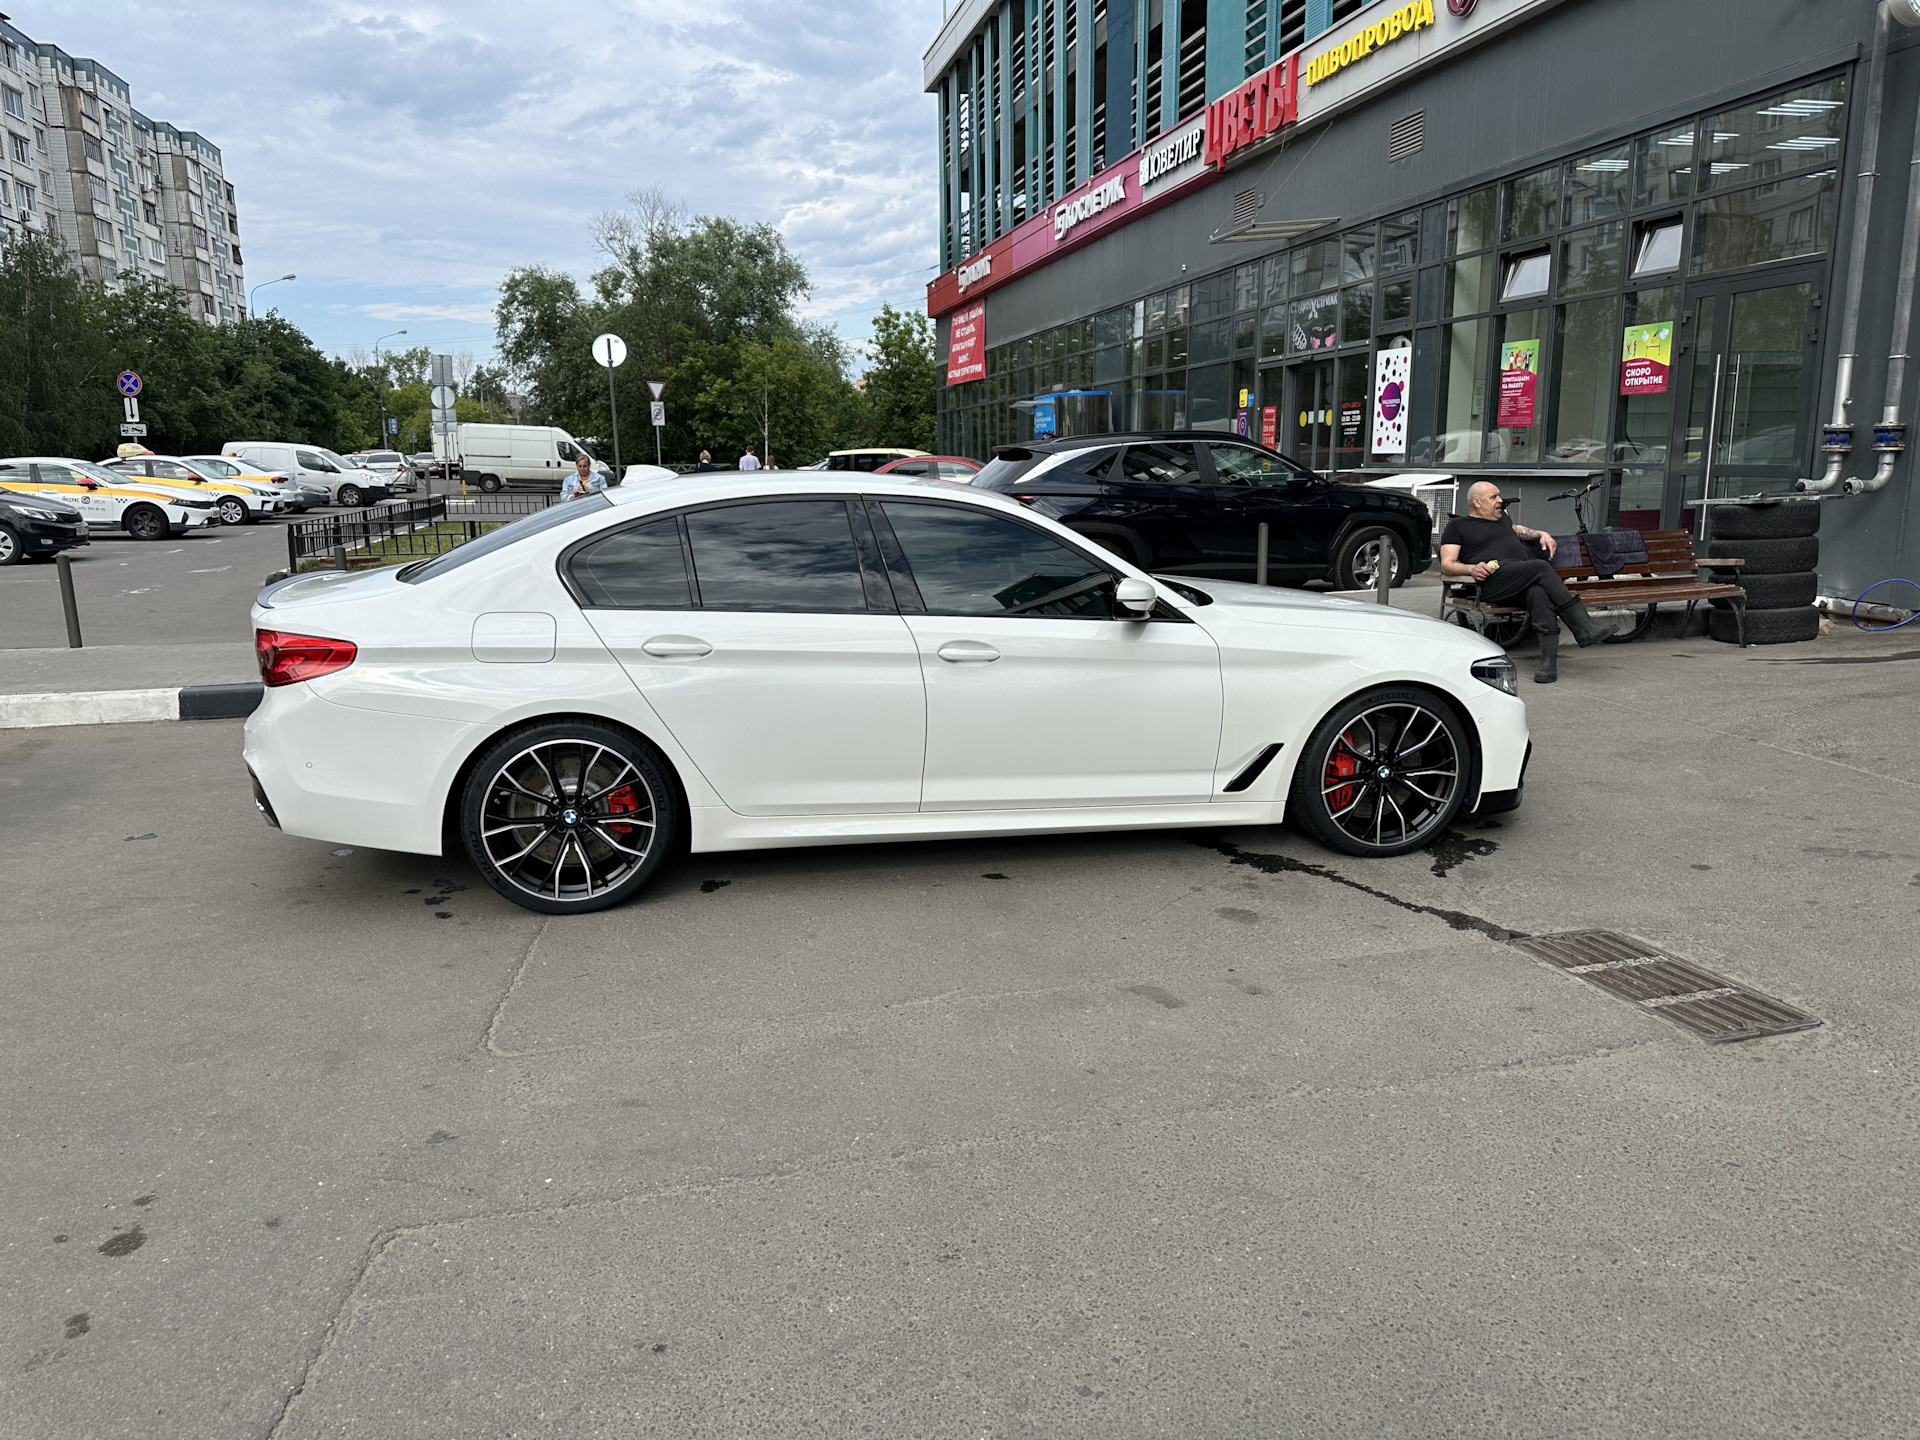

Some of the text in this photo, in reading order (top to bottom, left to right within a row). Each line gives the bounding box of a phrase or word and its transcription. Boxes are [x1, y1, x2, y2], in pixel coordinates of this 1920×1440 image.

[1306, 0, 1435, 86] ПИВОПРОВОД
[1204, 53, 1300, 172] ЦВЕТЫ
[1149, 128, 1202, 180] ЮВЕЛИР
[1502, 375, 1530, 383] ПРИГЛАШАЕМ
[1625, 375, 1663, 386] ОТКРЫТИЕ
[1626, 367, 1651, 377] СКОРО
